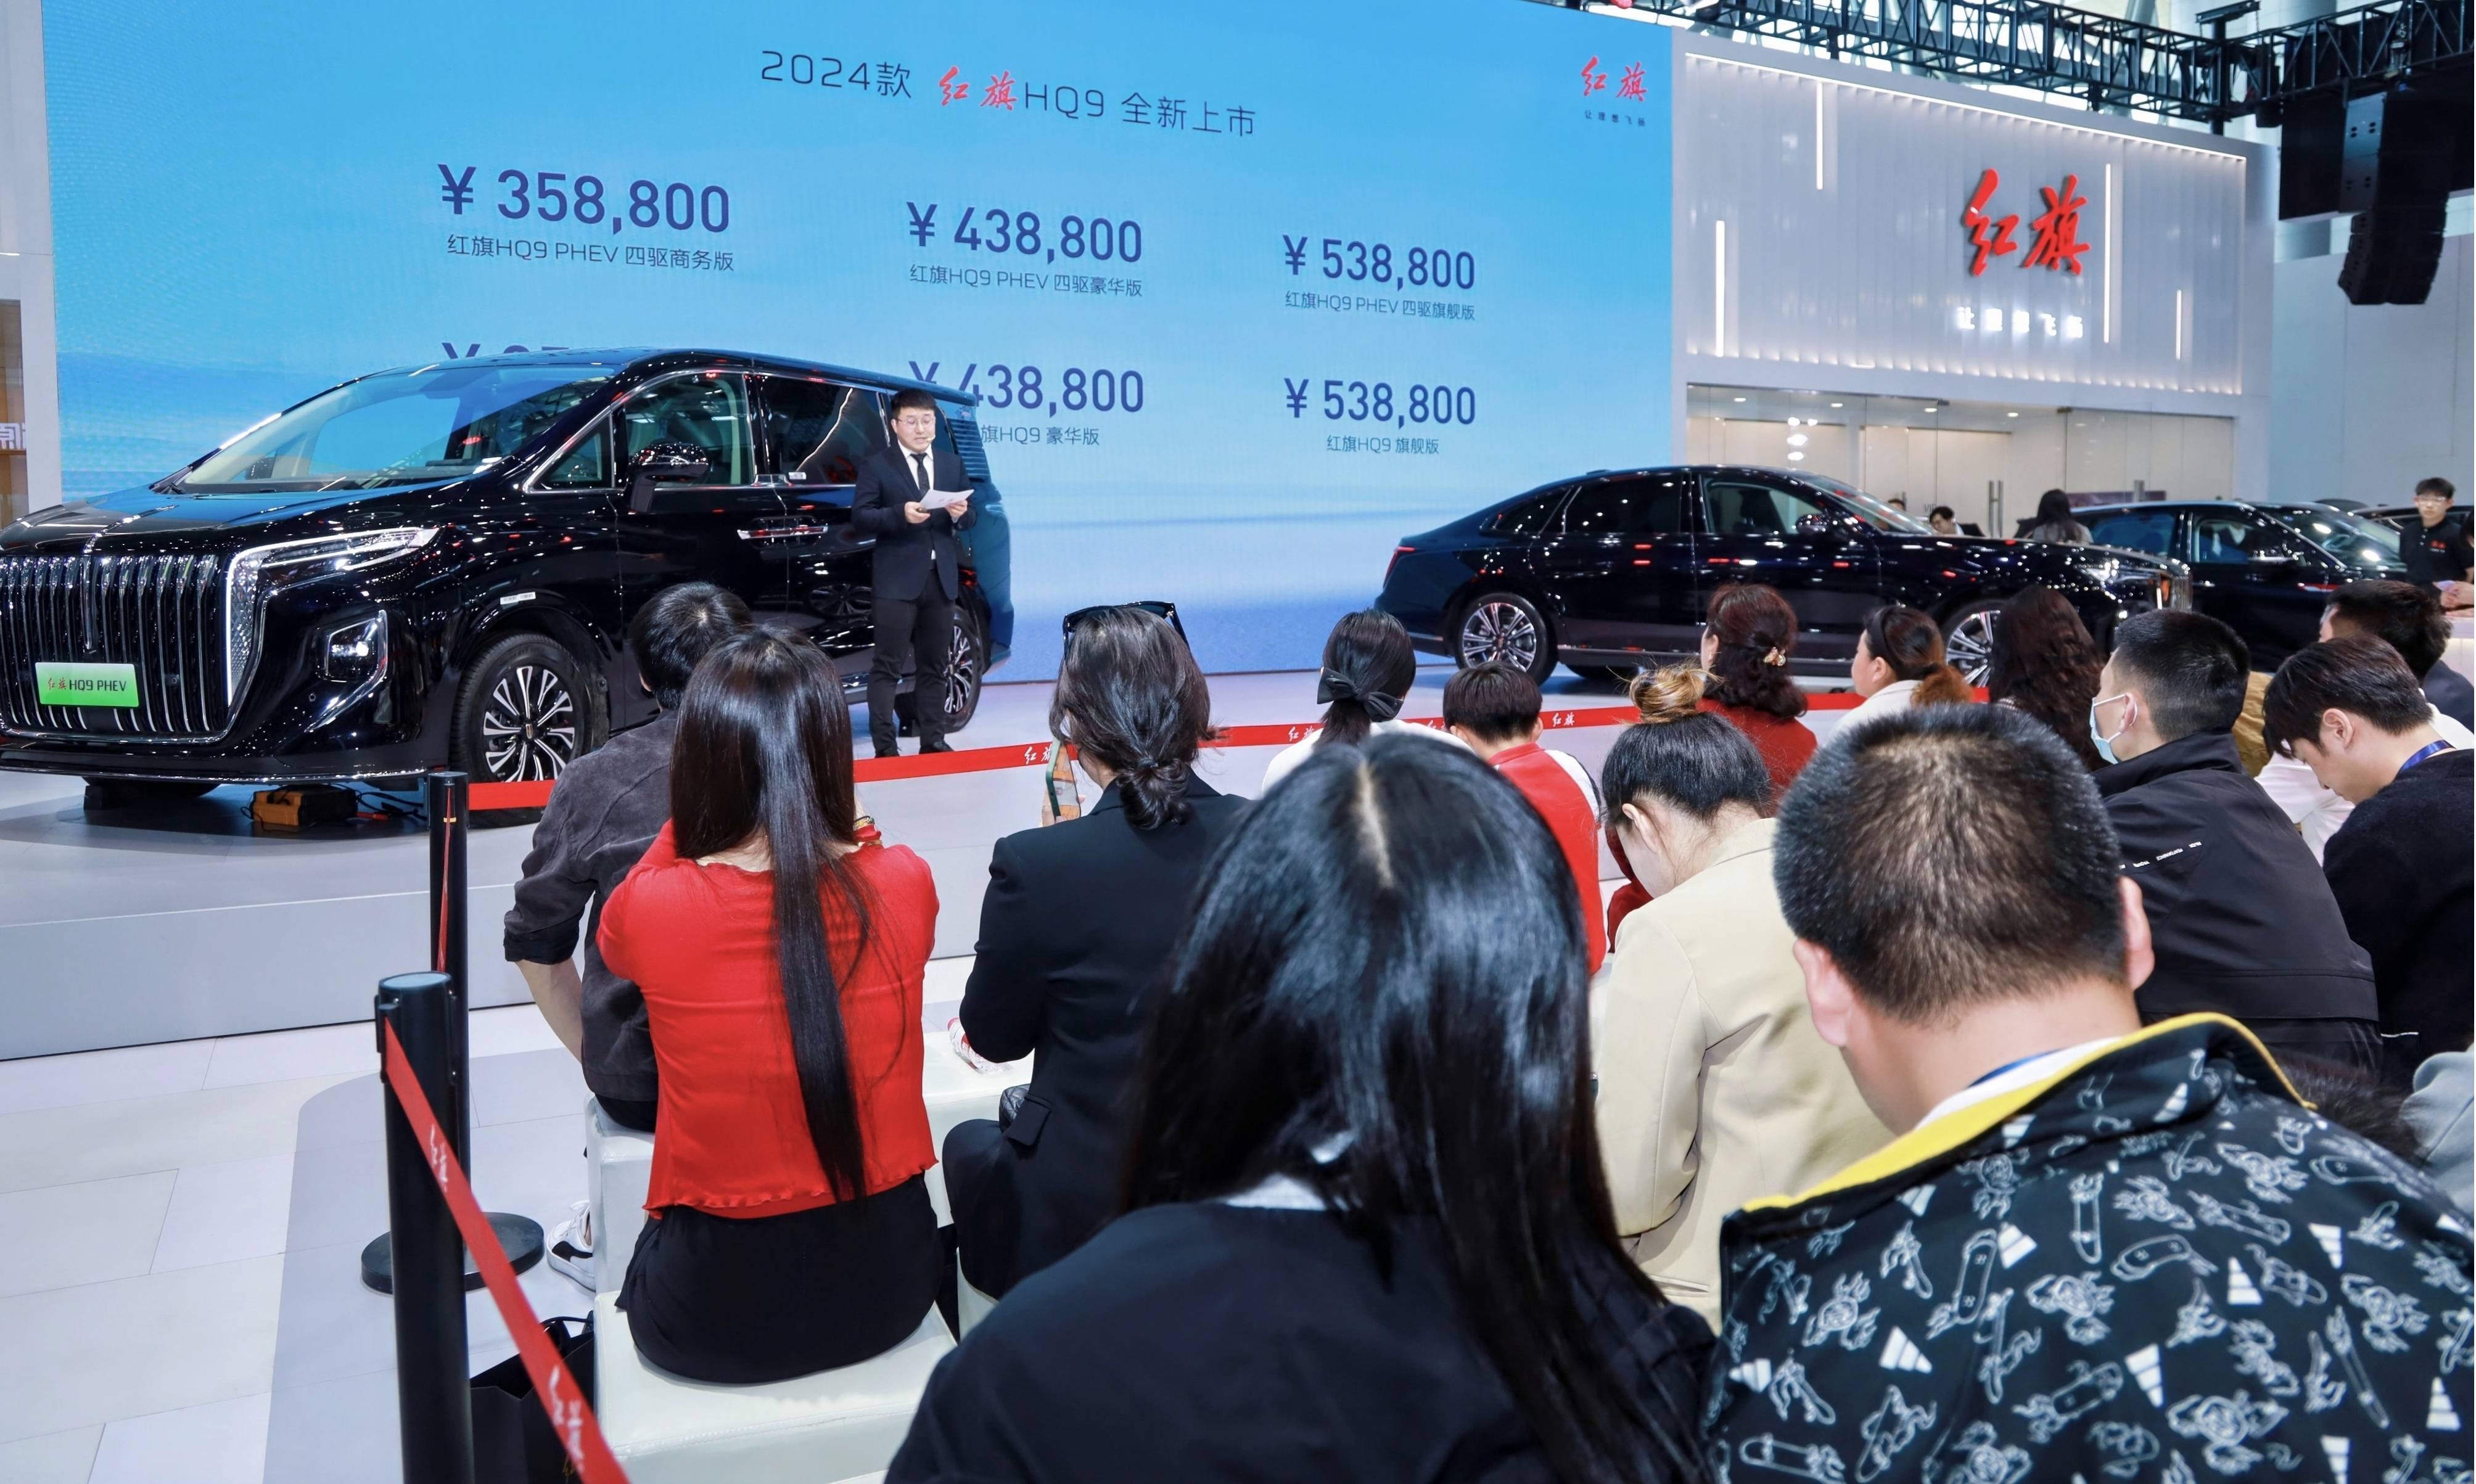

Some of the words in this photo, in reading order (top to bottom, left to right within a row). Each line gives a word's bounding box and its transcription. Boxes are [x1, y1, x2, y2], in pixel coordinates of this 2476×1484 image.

[762, 50, 911, 99] 2024款
[1121, 92, 1256, 137] 全新上市
[1581, 55, 1647, 102] 红旗
[498, 169, 729, 235] 358,800
[1961, 167, 2091, 277] 红旗
[447, 234, 547, 261] 红旗HQ9
[555, 242, 619, 263] PHEV
[625, 246, 734, 271] 四驱商务版
[954, 207, 1141, 264] 438,800
[910, 264, 991, 287] 红旗HQ9
[997, 271, 1049, 289] PHEV
[1054, 274, 1142, 297] 四驱豪华版
[1323, 238, 1474, 292] 538,800
[1285, 290, 1352, 312] 红旗HQ9
[1356, 297, 1399, 314] PHEV
[1402, 300, 1475, 321] 四驱旗舰版
[959, 363, 1143, 419] 438,800
[1324, 380, 1475, 430] 538,800
[980, 425, 1041, 445] 旗HQ9
[1046, 426, 1100, 446] 豪华版
[1326, 435, 1391, 454] 红旗HQ9
[1396, 437, 1439, 454] 旗舰版
[97, 680, 127, 692] PHEV
[1552, 711, 1575, 728] 红旗
